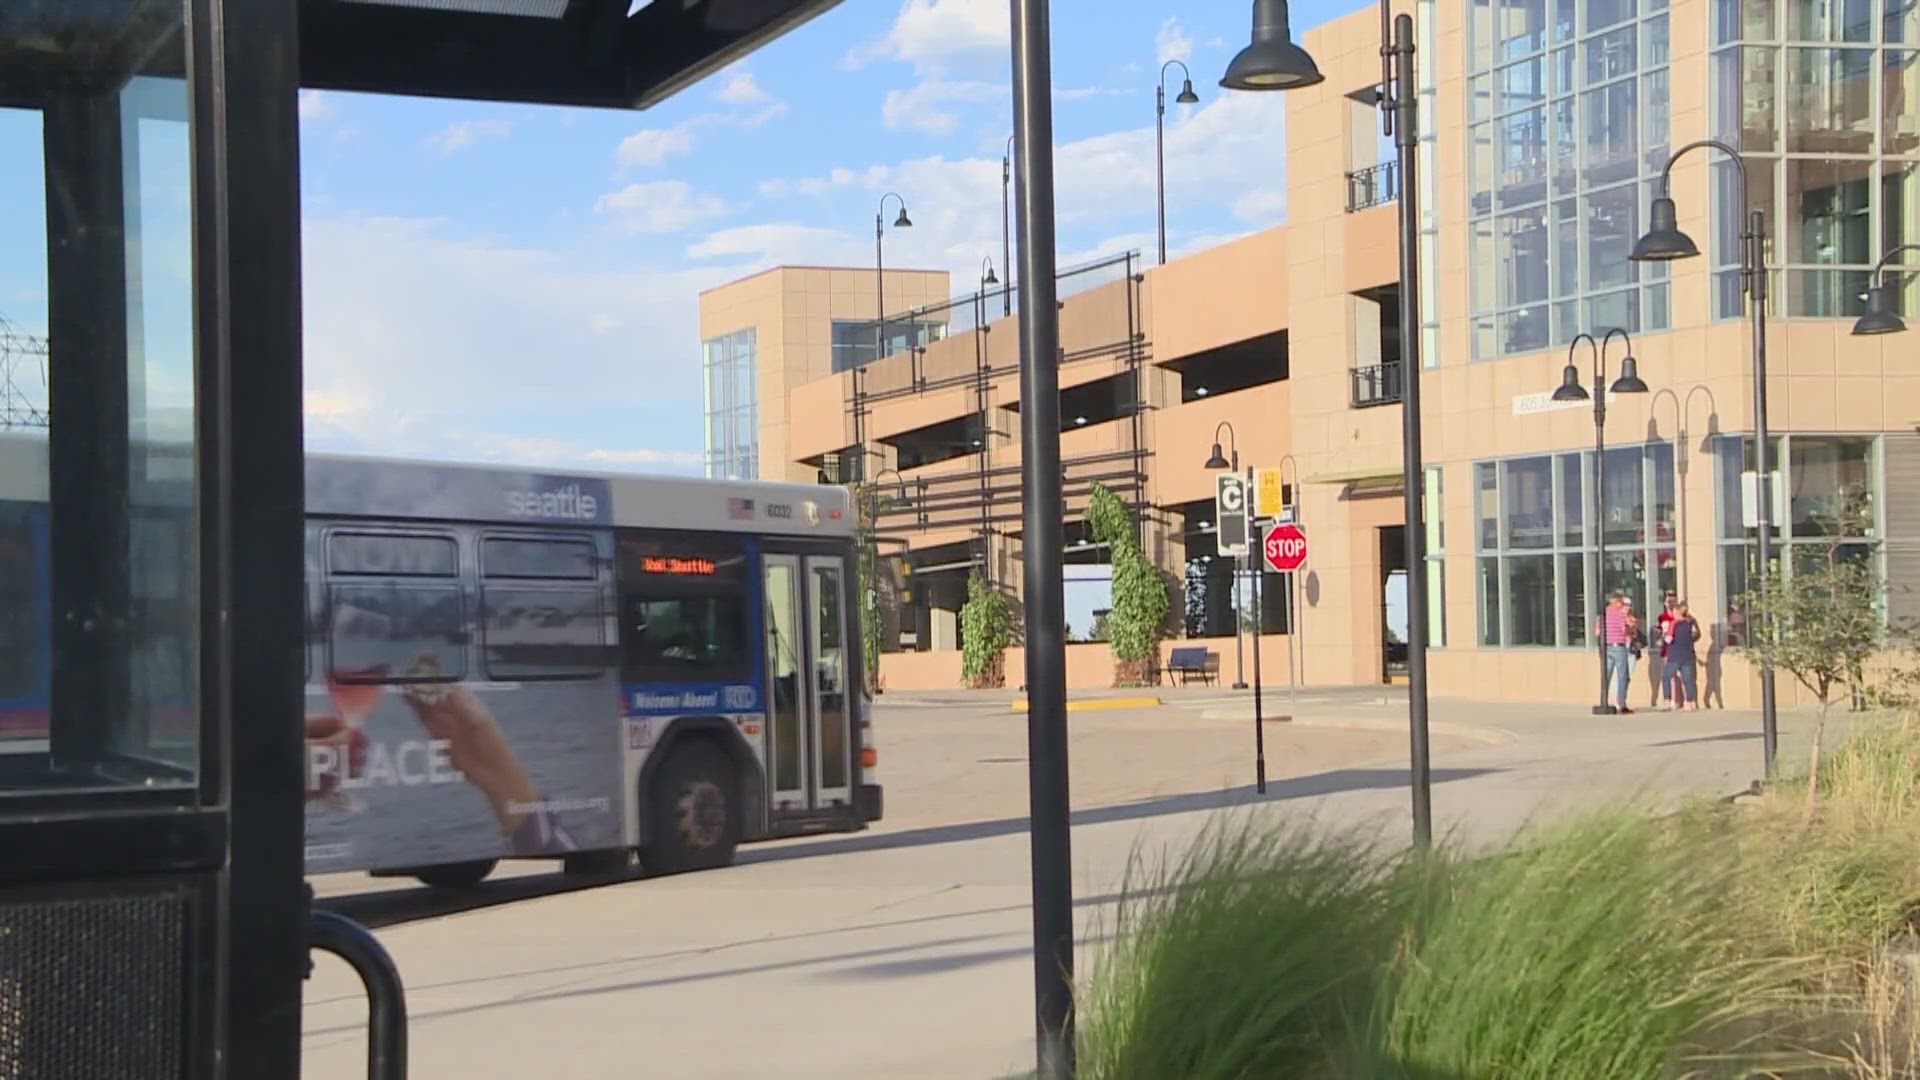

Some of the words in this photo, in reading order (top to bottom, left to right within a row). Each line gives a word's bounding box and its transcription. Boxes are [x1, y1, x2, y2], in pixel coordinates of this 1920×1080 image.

[509, 483, 598, 519] seattle
[1222, 485, 1242, 510] C
[1267, 537, 1306, 559] STOP
[309, 738, 466, 791] PLACE.
